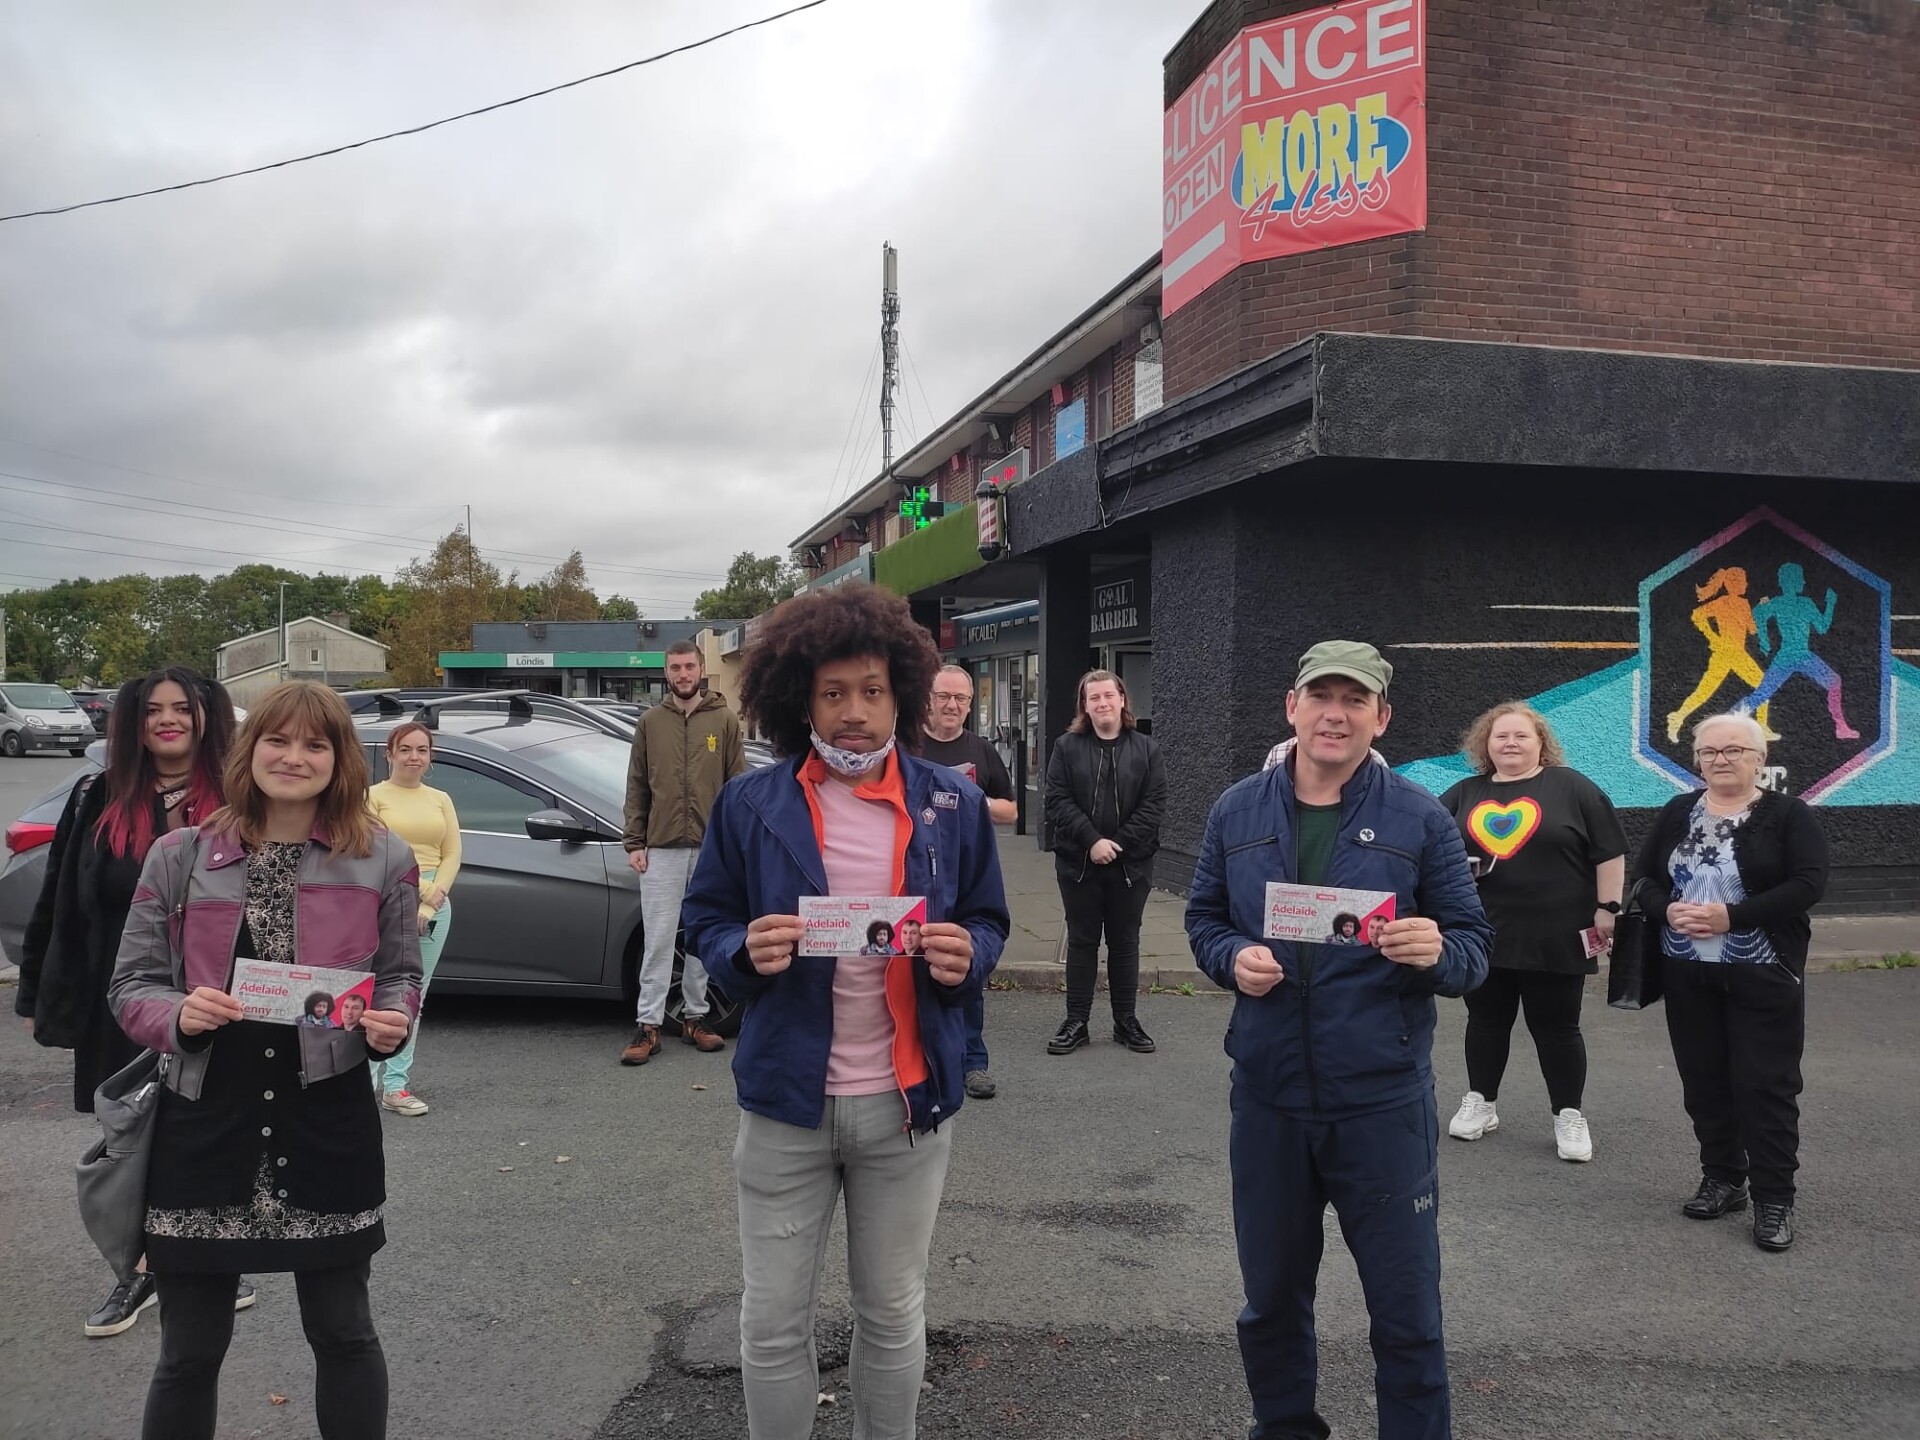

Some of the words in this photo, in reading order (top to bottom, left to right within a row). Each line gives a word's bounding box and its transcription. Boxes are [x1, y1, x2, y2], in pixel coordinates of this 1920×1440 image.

[1241, 92, 1387, 209] MORE
[1164, 141, 1223, 233] OPEN
[1239, 182, 1280, 242] 4
[1098, 584, 1129, 609] GOAL
[1090, 607, 1138, 633] BARBER
[516, 657, 545, 666] Londis
[1271, 904, 1317, 917] Adelaide
[805, 918, 851, 928] Adelaide
[1271, 922, 1303, 935] Kenny
[805, 939, 838, 949] Kenny
[239, 982, 289, 996] Adelaide
[1413, 1193, 1433, 1214] HH
